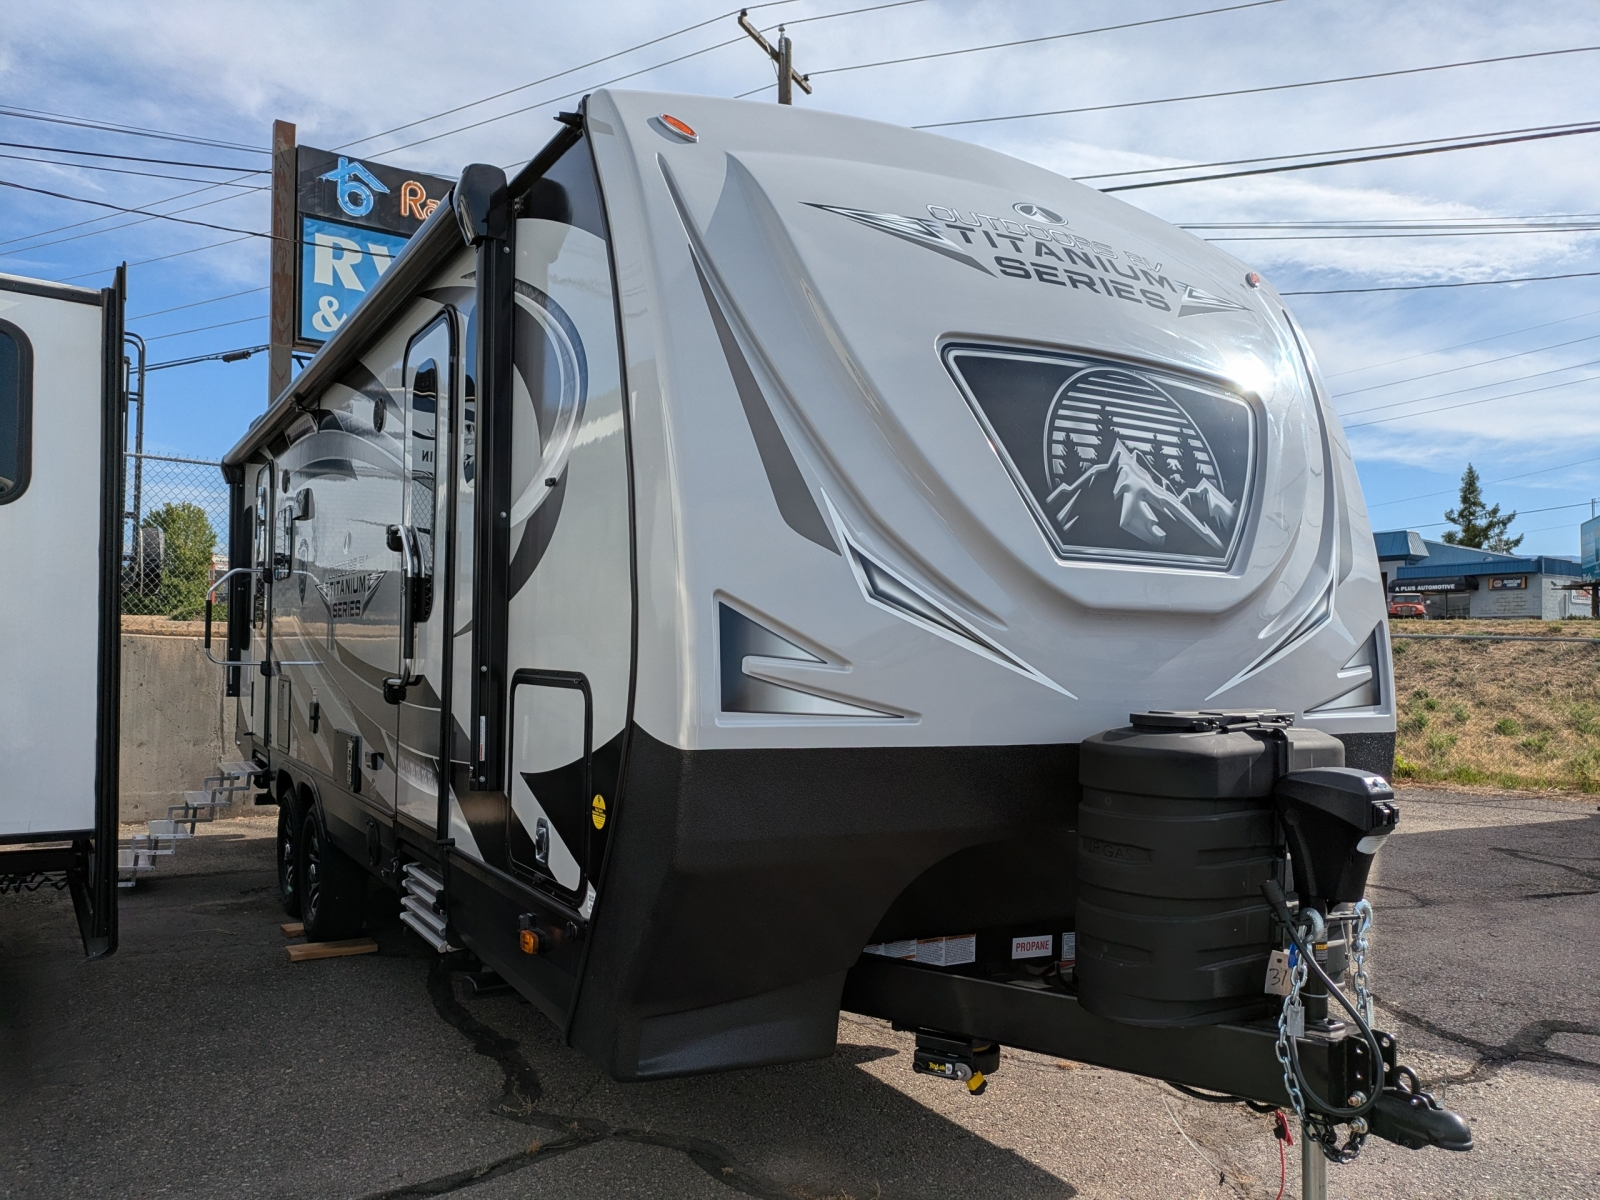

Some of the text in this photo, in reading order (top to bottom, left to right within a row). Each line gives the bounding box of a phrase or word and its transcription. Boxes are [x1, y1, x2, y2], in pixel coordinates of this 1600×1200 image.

[926, 204, 1118, 259] OUTDOORS
[945, 223, 1177, 293] TITANIUM
[994, 255, 1172, 312] SERIES
[329, 575, 366, 597] TITANIUM
[1417, 583, 1455, 591] AUTOMOTIVE
[332, 600, 361, 618] SERIES
[1103, 844, 1133, 860] GAS
[1015, 940, 1050, 952] PROPANE
